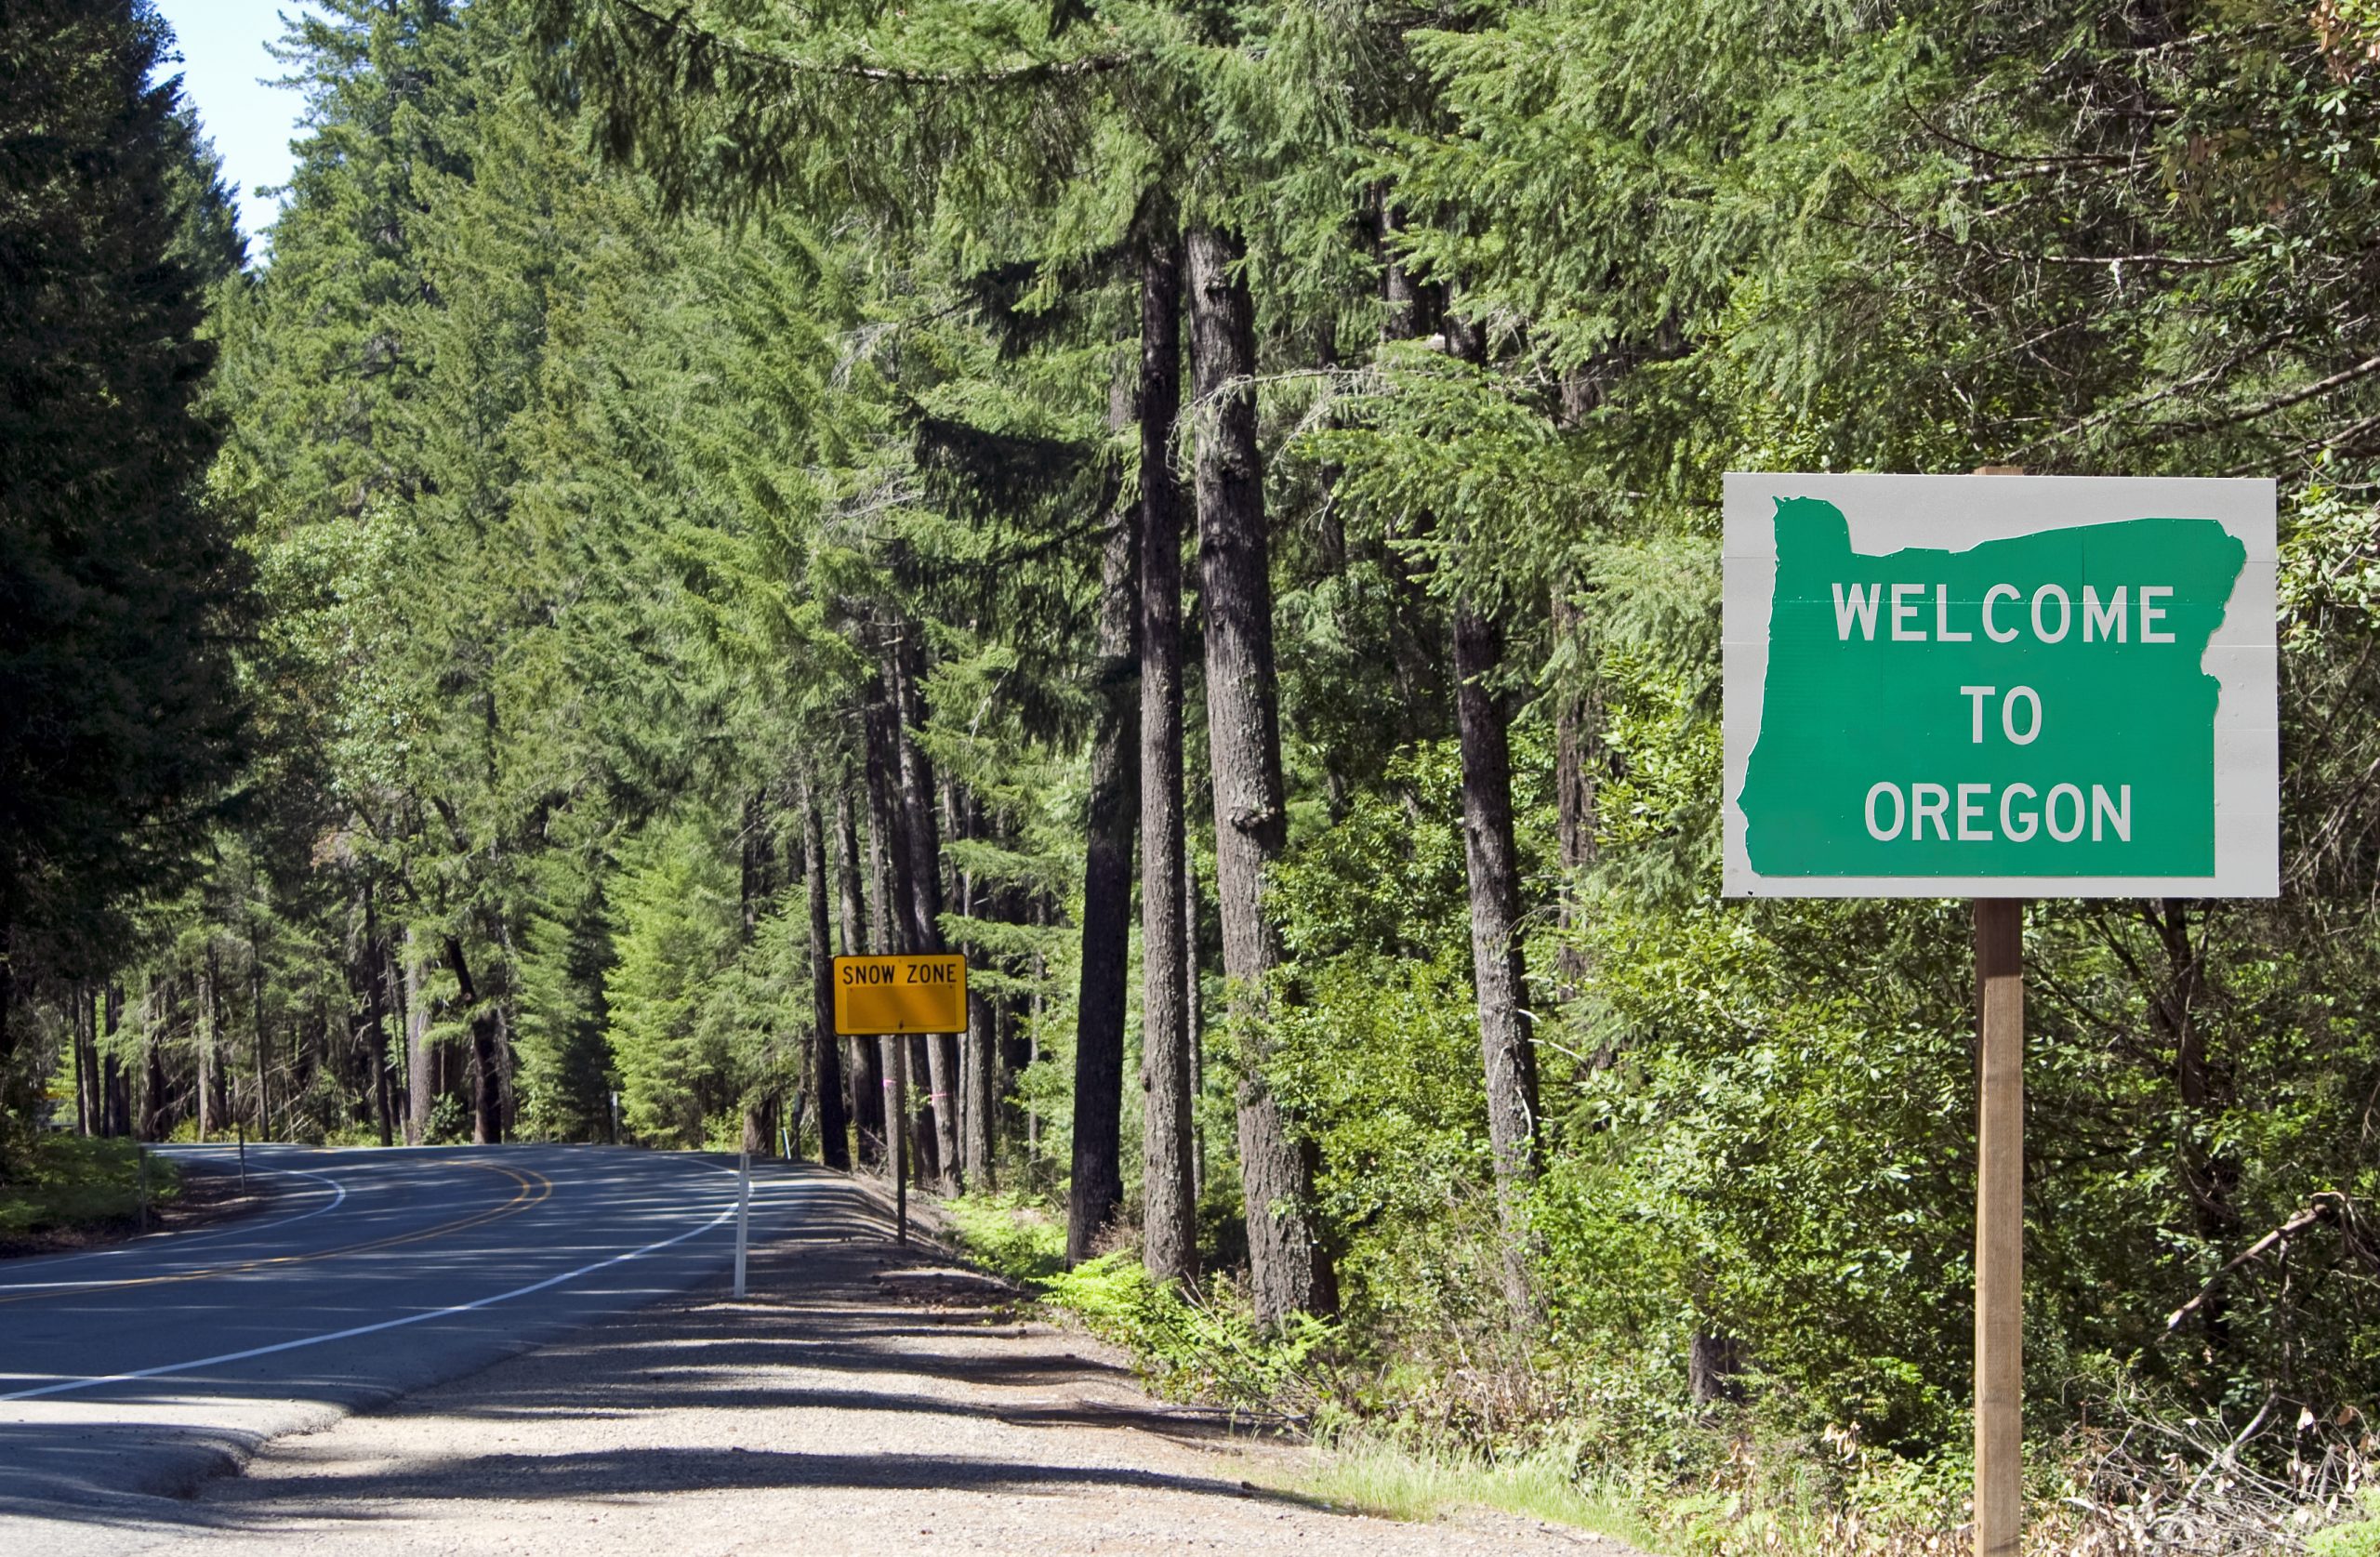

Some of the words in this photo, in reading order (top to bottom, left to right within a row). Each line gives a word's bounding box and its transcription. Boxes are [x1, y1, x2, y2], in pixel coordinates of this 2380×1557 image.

[1831, 583, 2175, 644] WELCOME
[1960, 685, 2043, 746] TO
[1864, 782, 2131, 842] OREGON
[842, 965, 895, 984] SNOW
[906, 964, 957, 983] ZONE
